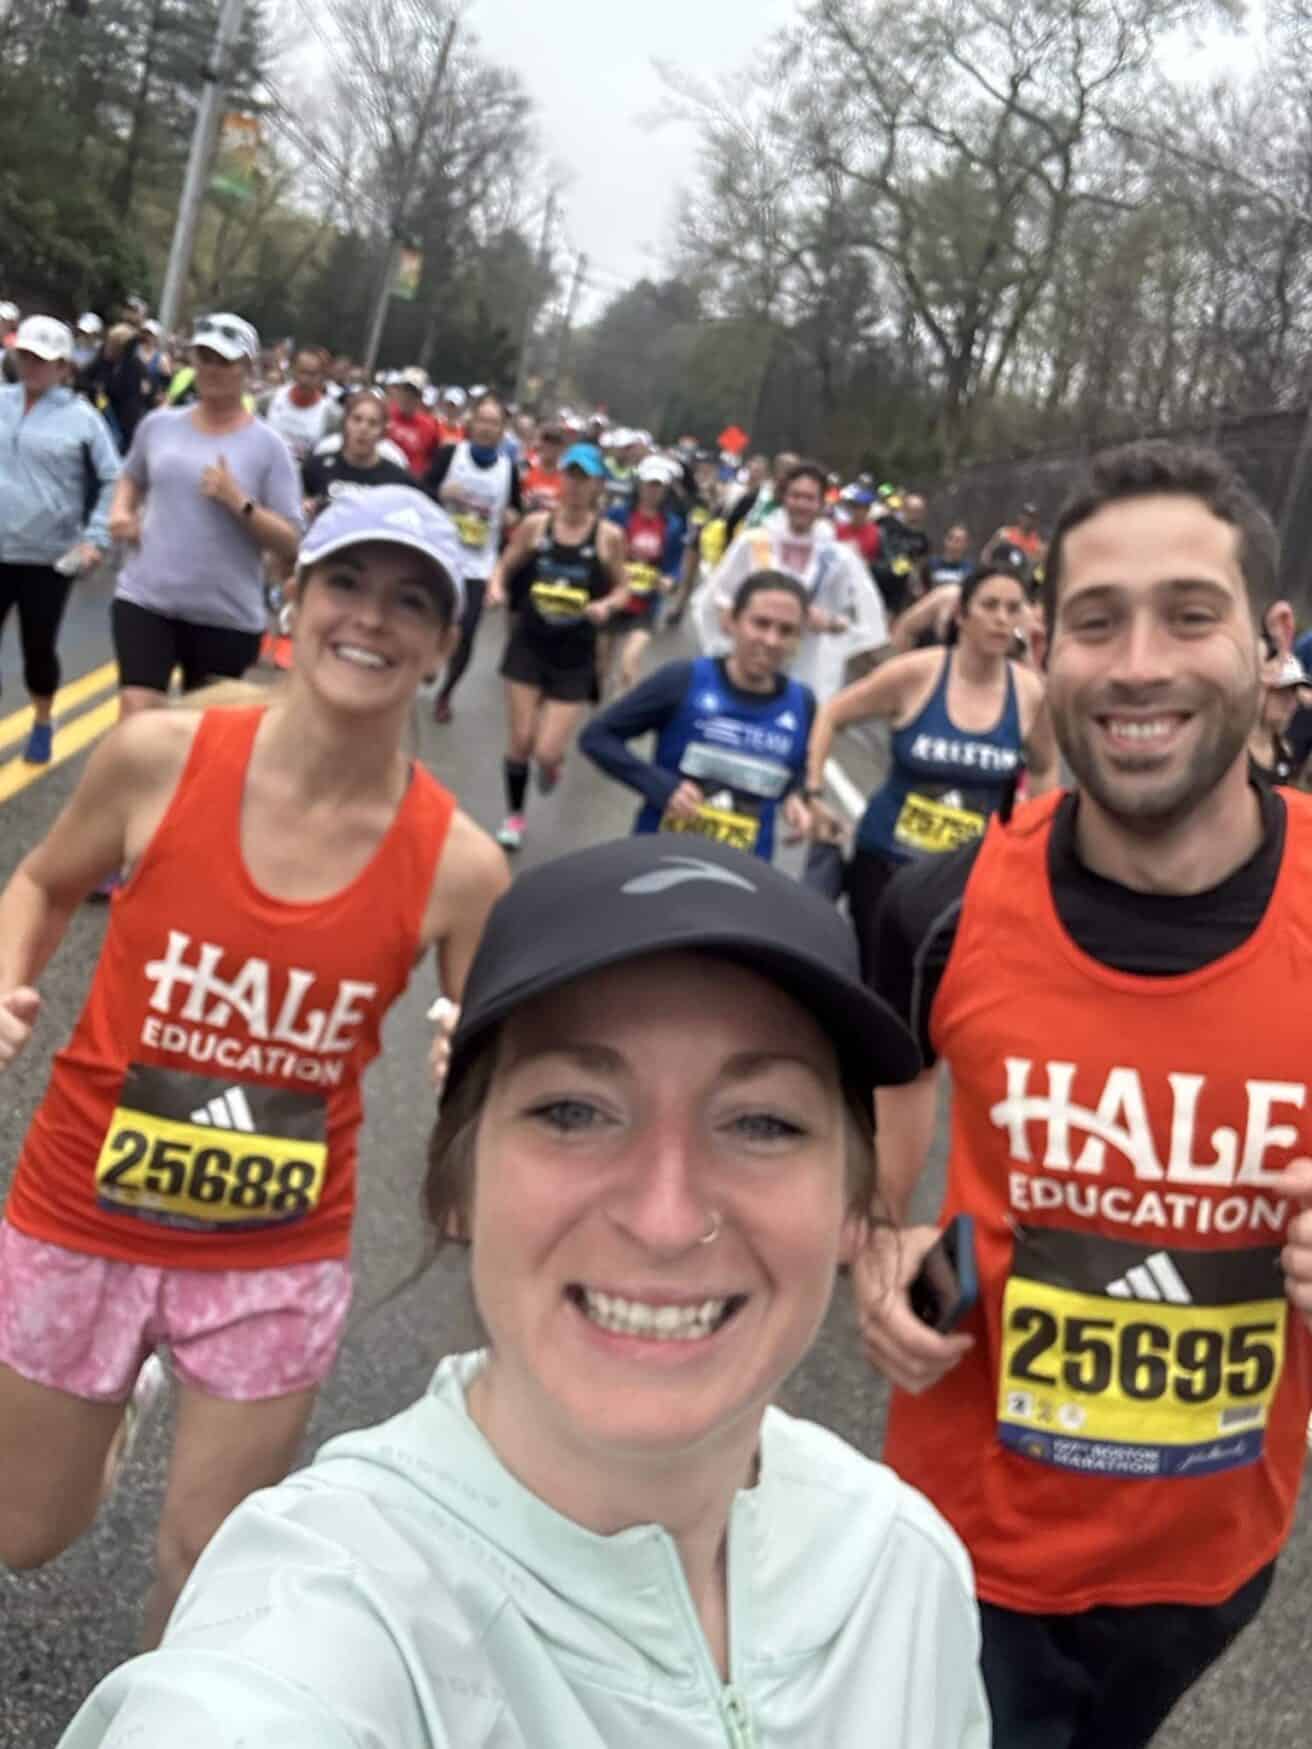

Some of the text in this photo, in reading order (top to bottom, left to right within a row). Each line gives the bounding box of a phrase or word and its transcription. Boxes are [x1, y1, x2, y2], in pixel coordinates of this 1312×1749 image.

[144, 930, 377, 1054] HALE
[141, 1019, 344, 1087] EDUCATION
[989, 1057, 1305, 1187] HALE
[100, 1130, 316, 1213] 25688
[1008, 1173, 1288, 1233] EDUCATION
[1008, 1307, 1277, 1406] 25695
